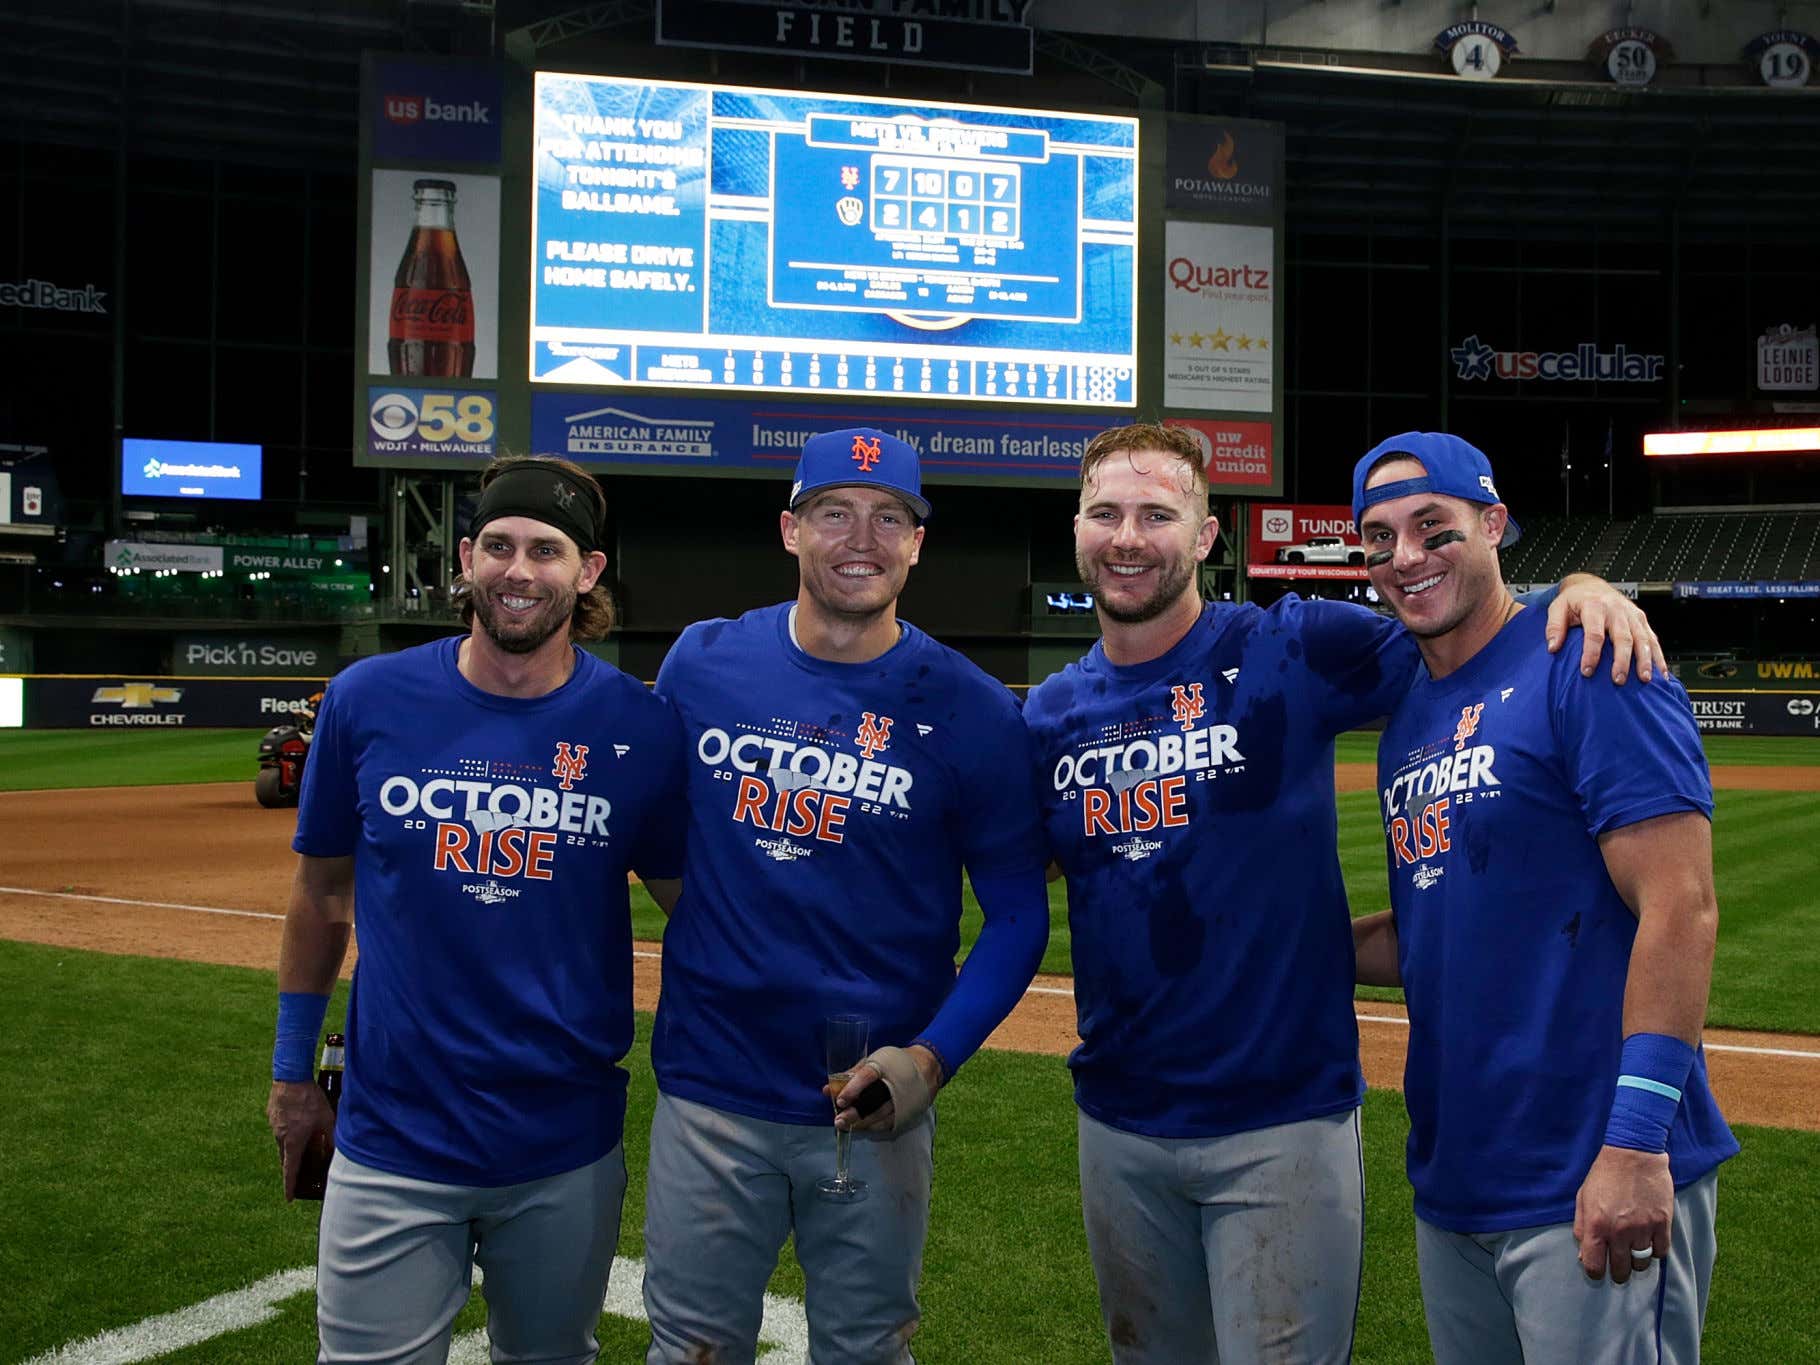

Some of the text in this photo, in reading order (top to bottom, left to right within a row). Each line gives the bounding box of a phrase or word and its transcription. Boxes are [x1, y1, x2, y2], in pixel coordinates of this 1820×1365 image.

[777, 11, 923, 53] FIELD
[1447, 23, 1506, 43] MOLITOR
[1465, 44, 1484, 71] 4
[1617, 46, 1647, 67] 50
[1767, 53, 1804, 79] 19
[388, 97, 490, 124] us bank
[562, 114, 683, 141] THANK YOU
[883, 169, 900, 192] 7
[914, 172, 942, 195] 10
[955, 175, 973, 197] 0
[991, 178, 1009, 199] 7
[1174, 178, 1271, 198] POTAWATOMI
[882, 204, 1009, 233] 2 4 1 2
[546, 240, 694, 268] PLEASE DRIVE
[544, 266, 696, 292] HOME SAFELY.
[1168, 257, 1270, 293] Quartz
[0, 279, 108, 314] edBank
[1495, 343, 1665, 382] uscellular
[1763, 348, 1813, 365] LEINIE
[1763, 367, 1813, 384] LODGE
[417, 393, 494, 443] 58
[568, 425, 712, 442] AMERICAN FAMILY
[752, 424, 817, 448] Insur
[930, 432, 995, 455] dream
[1001, 434, 1091, 458] fearlessl
[1216, 432, 1243, 444] uw
[374, 441, 492, 454] WDJT MILWAUKEE
[579, 440, 701, 454] INSURANCE
[1216, 445, 1266, 460] credit
[1216, 461, 1268, 475] union
[1299, 519, 1359, 535] TUNDR
[233, 554, 323, 570] POWER ALLEY
[1298, 568, 1317, 577] YOUR
[260, 646, 318, 666] Save
[261, 698, 309, 714] Fleet
[1691, 701, 1745, 715] TRUST
[90, 714, 186, 725] CHEVROLET
[1716, 720, 1742, 729] BANK
[1053, 724, 1247, 791] OCTOBER
[698, 727, 913, 811] OCTOBER
[713, 769, 733, 781] 20
[1195, 769, 1217, 782] 22
[1062, 790, 1077, 801] 20
[1455, 792, 1473, 805] 22
[379, 776, 611, 837] OCTOBER
[732, 774, 852, 844] RISE
[860, 802, 882, 815] 22
[1083, 775, 1189, 837] RISE
[404, 819, 427, 830] 20
[1391, 797, 1451, 869] RISE
[566, 835, 586, 847] 22
[755, 837, 812, 857] POSTSEASON
[1112, 840, 1163, 854] POSTSEASON
[433, 822, 558, 881] RISE
[462, 883, 521, 898] POSTSEASON
